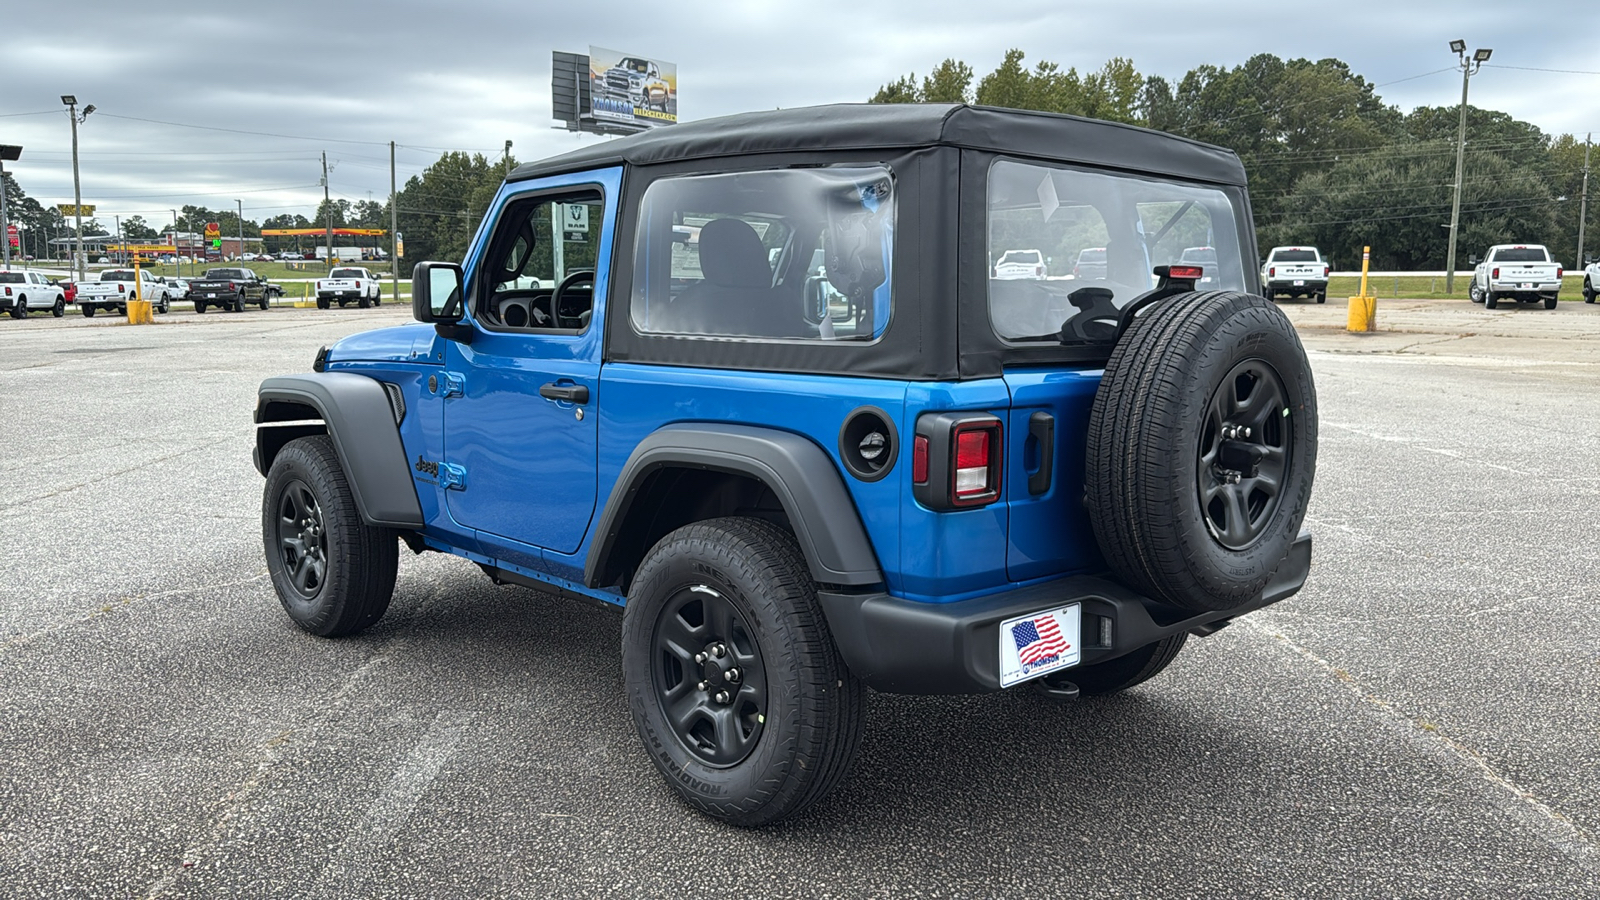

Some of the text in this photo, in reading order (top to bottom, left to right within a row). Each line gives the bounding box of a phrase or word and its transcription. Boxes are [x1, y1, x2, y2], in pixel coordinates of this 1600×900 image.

[593, 97, 634, 115] THOMSON
[415, 454, 439, 479] Jeep
[697, 563, 762, 628] NEXEN
[1031, 653, 1060, 670] THOMSON
[660, 750, 722, 796] ROADIAN
